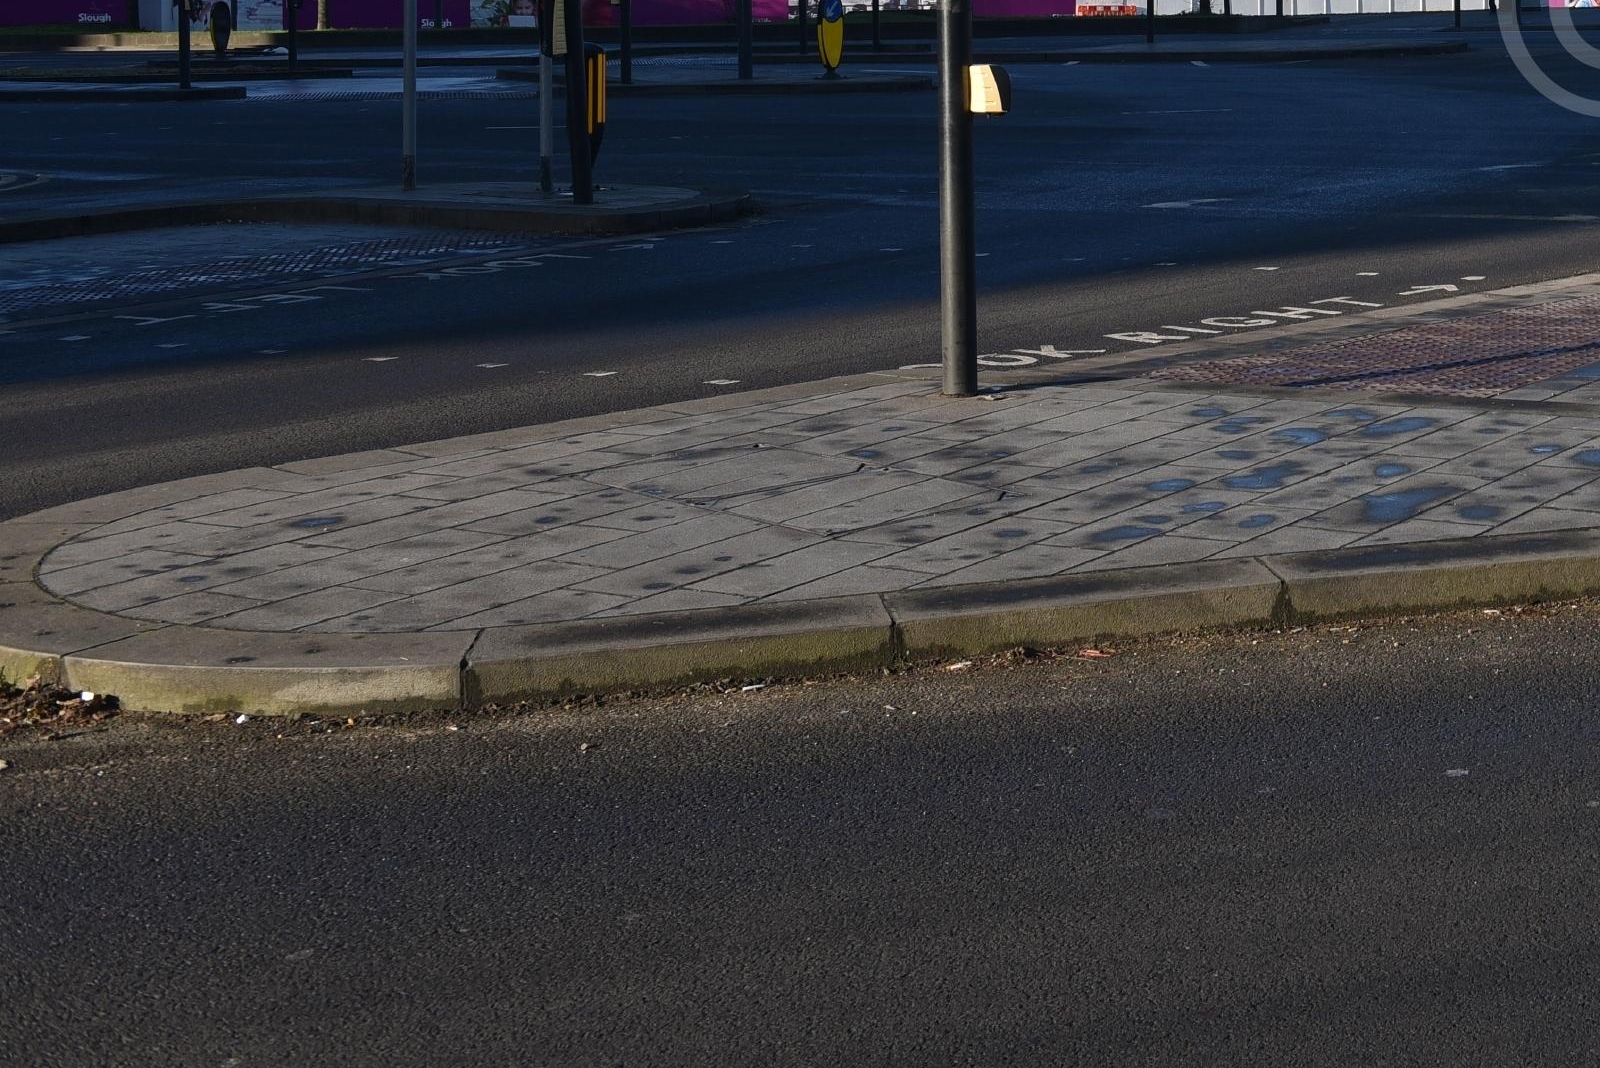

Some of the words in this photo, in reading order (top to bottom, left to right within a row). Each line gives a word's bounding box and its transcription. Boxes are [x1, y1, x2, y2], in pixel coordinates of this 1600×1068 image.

[78, 13, 112, 23] Slough
[421, 18, 452, 29] Slogh
[1103, 295, 1384, 344] RIGHT
